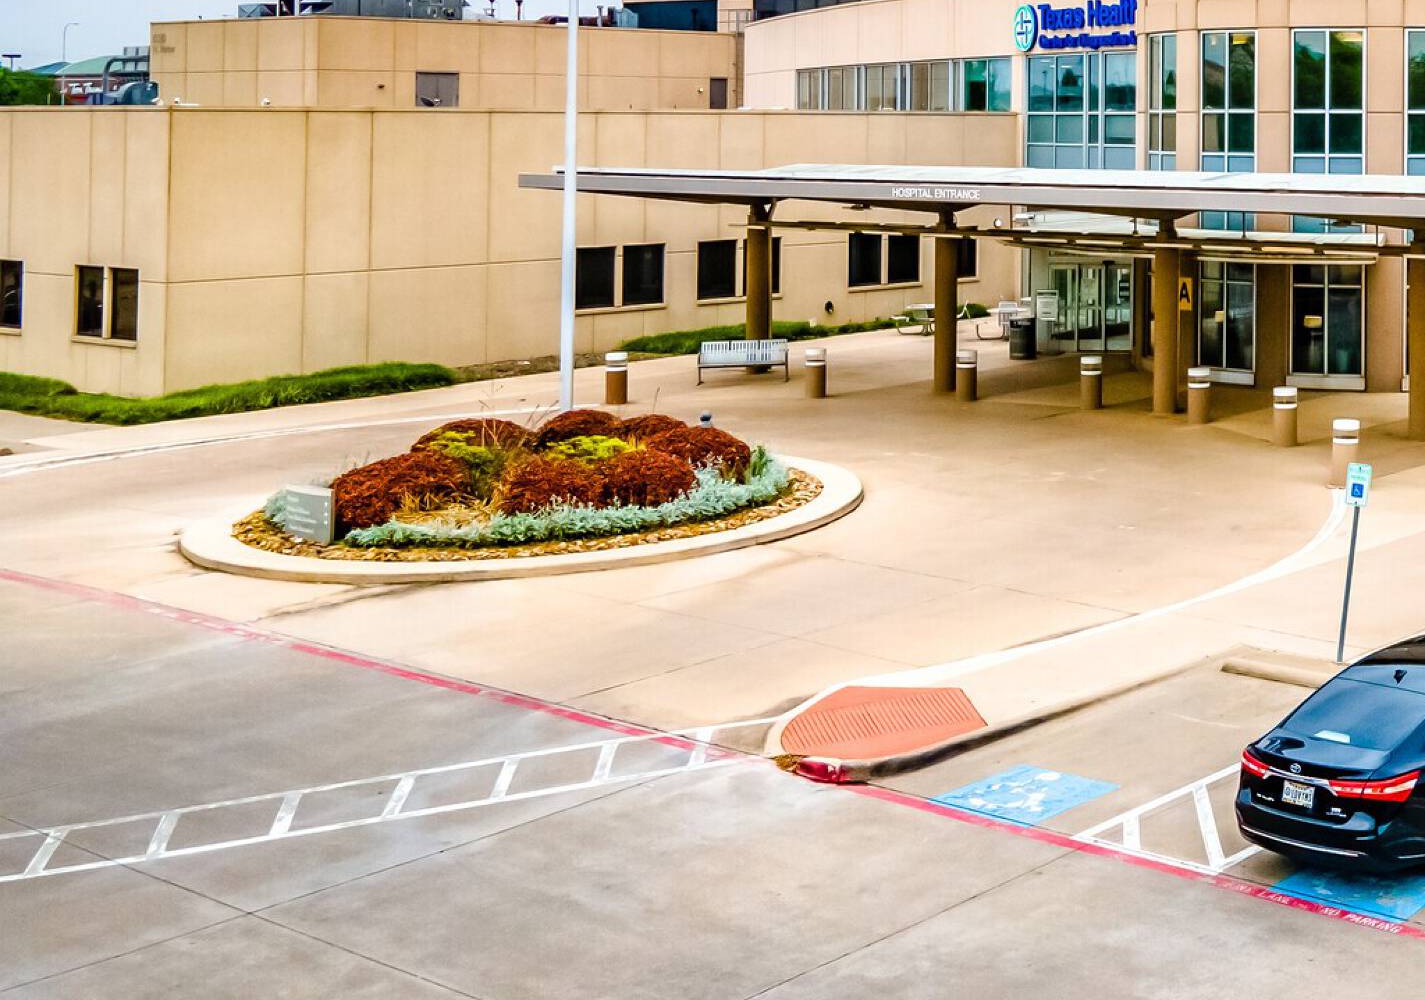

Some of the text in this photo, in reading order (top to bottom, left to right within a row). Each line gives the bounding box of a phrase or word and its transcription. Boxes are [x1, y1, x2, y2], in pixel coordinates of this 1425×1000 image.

[1038, 3, 1085, 30] Texas
[891, 187, 980, 200] HOSPITAL ENTRANCE
[1180, 281, 1191, 304] A
[1345, 913, 1402, 935] PARKING
